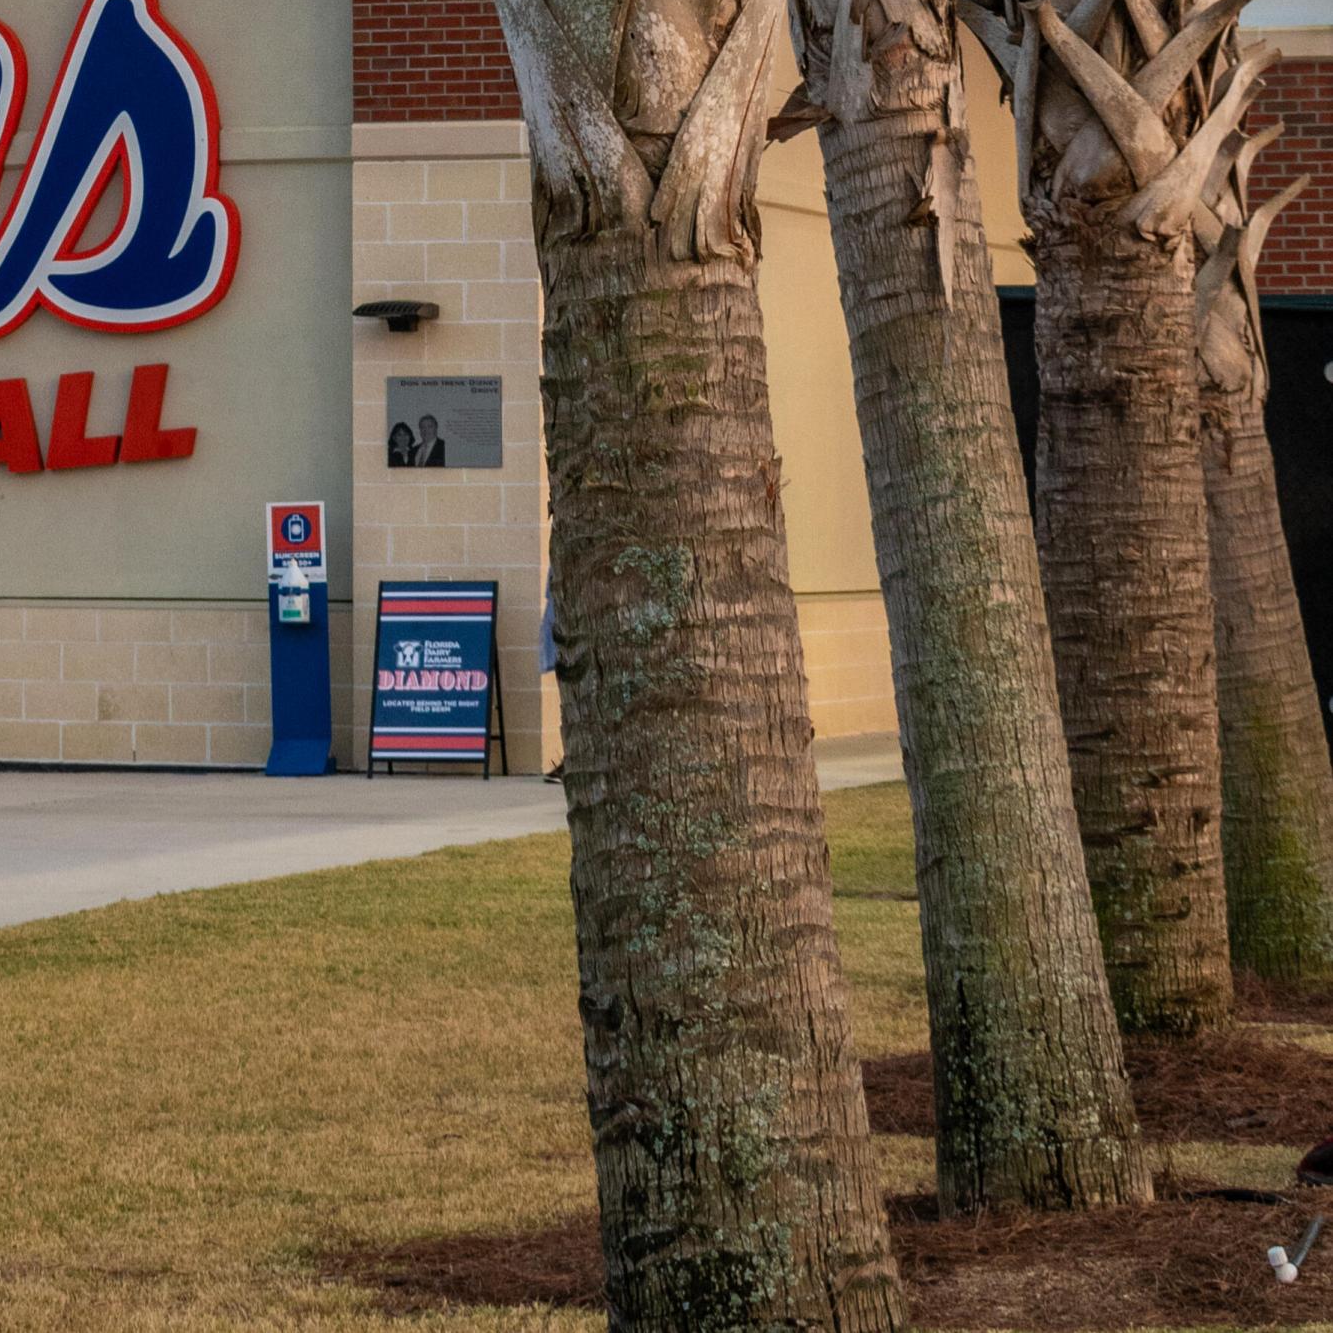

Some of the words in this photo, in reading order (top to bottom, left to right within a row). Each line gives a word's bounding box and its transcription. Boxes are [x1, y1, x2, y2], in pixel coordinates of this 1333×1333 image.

[424, 640, 461, 649] FLORIDA
[424, 648, 451, 656] DAIRY
[424, 655, 462, 664] FARMERS
[378, 670, 488, 691] DIAMOND
[382, 699, 415, 707] LOCATED
[416, 699, 443, 707] BEHIND
